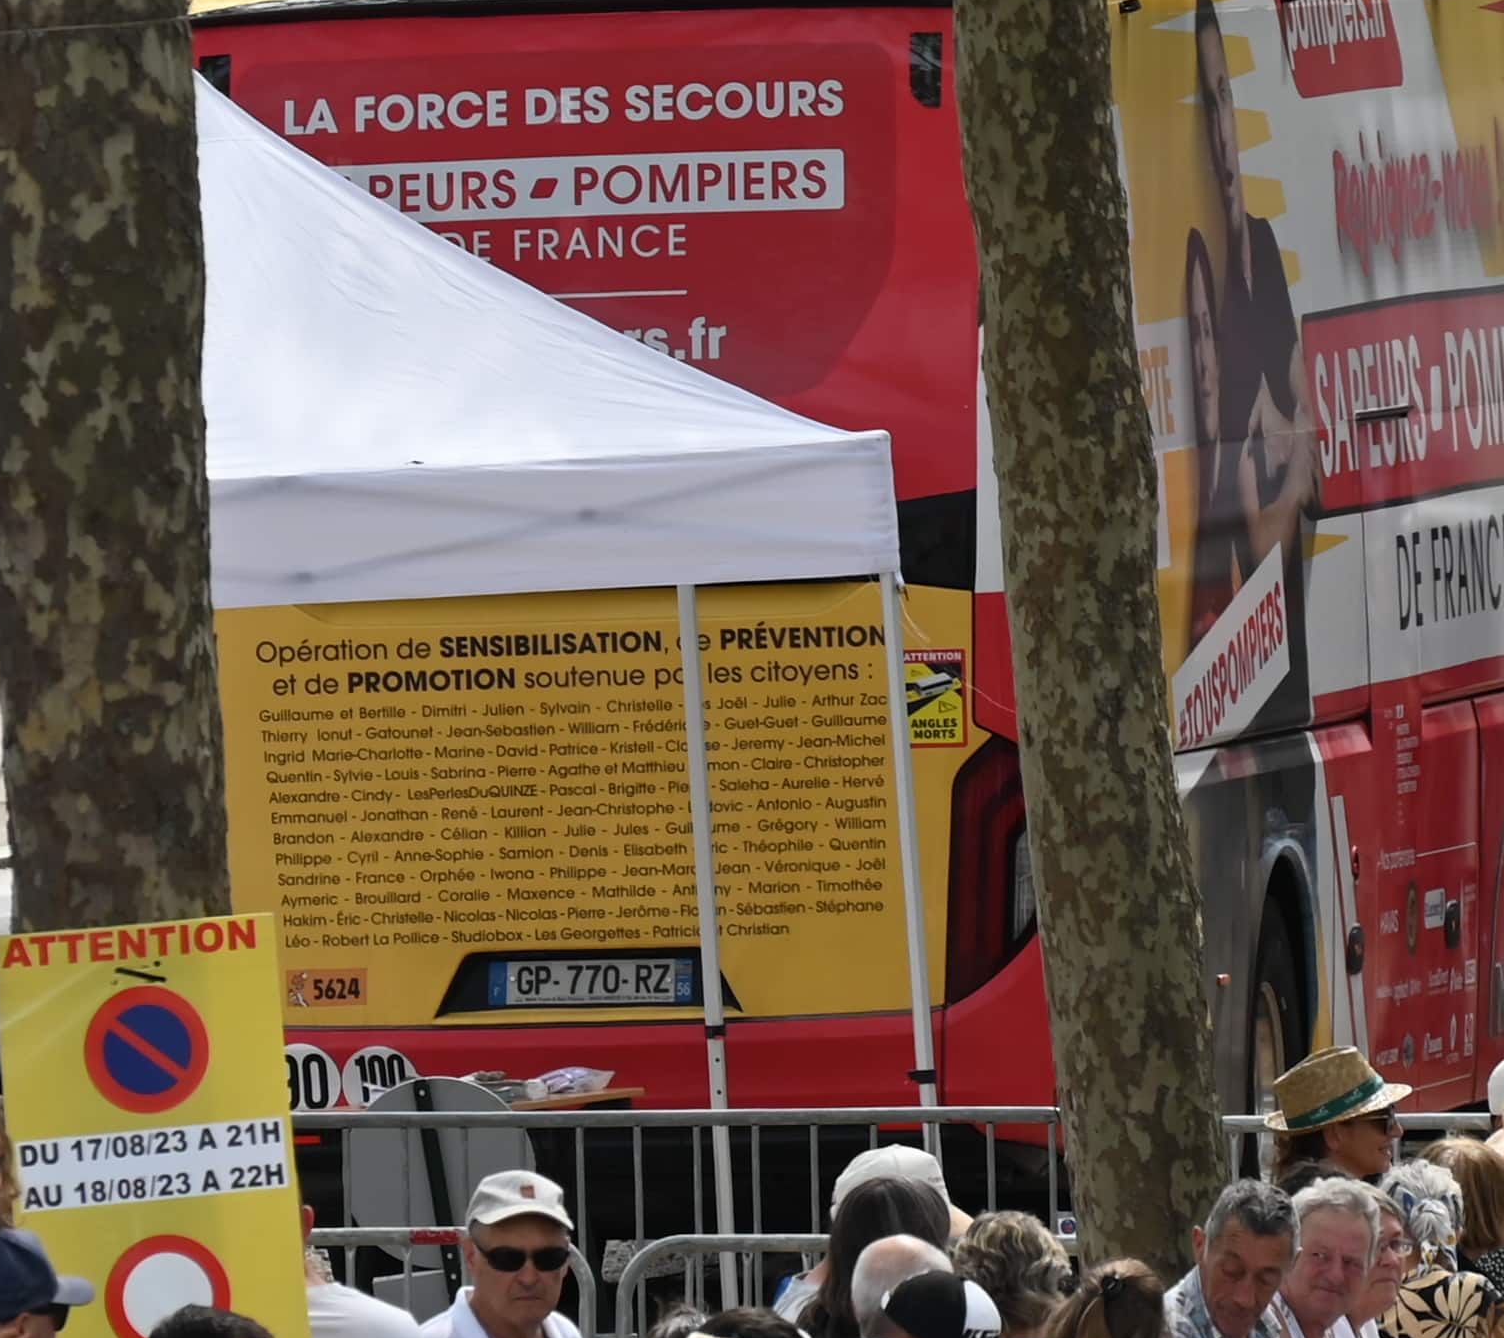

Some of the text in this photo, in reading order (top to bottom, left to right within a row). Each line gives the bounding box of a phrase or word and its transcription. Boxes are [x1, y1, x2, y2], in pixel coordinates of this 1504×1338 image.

[284, 79, 845, 136] LA FORCE DES SECOURS
[574, 159, 828, 206] POMPIERS
[514, 224, 689, 262] FRANCE
[1315, 335, 1428, 477] SAPEURS
[1395, 529, 1424, 631] DE
[256, 622, 886, 667] Opération de SENSIBILISATION, PRÉVENTION
[904, 650, 962, 662] ATTENTION
[272, 657, 860, 696] et de PROMOTION soutenue les citoyens
[259, 692, 887, 722] Guillaume et Bertille Dimitri Julien Sylvain Christelle Joël Julie Arthur Zac
[910, 718, 959, 730] ANGLES
[261, 713, 887, 745] Thierry Ionut Gatounet Jean-Sebastien William Guet-Guet Guillaume
[913, 728, 957, 740] MORTS
[264, 733, 885, 767] Ingrid Marie-Charlotte Marine David Patrice Kristell Jeremy Jean-Michel
[2, 919, 258, 969] ATTENTION
[313, 977, 361, 1000] 5624
[676, 981, 691, 997] 56
[20, 1121, 282, 1168] DU 17/08/23 A 21H
[24, 1162, 285, 1211] AU 18/08/23 A 22H
